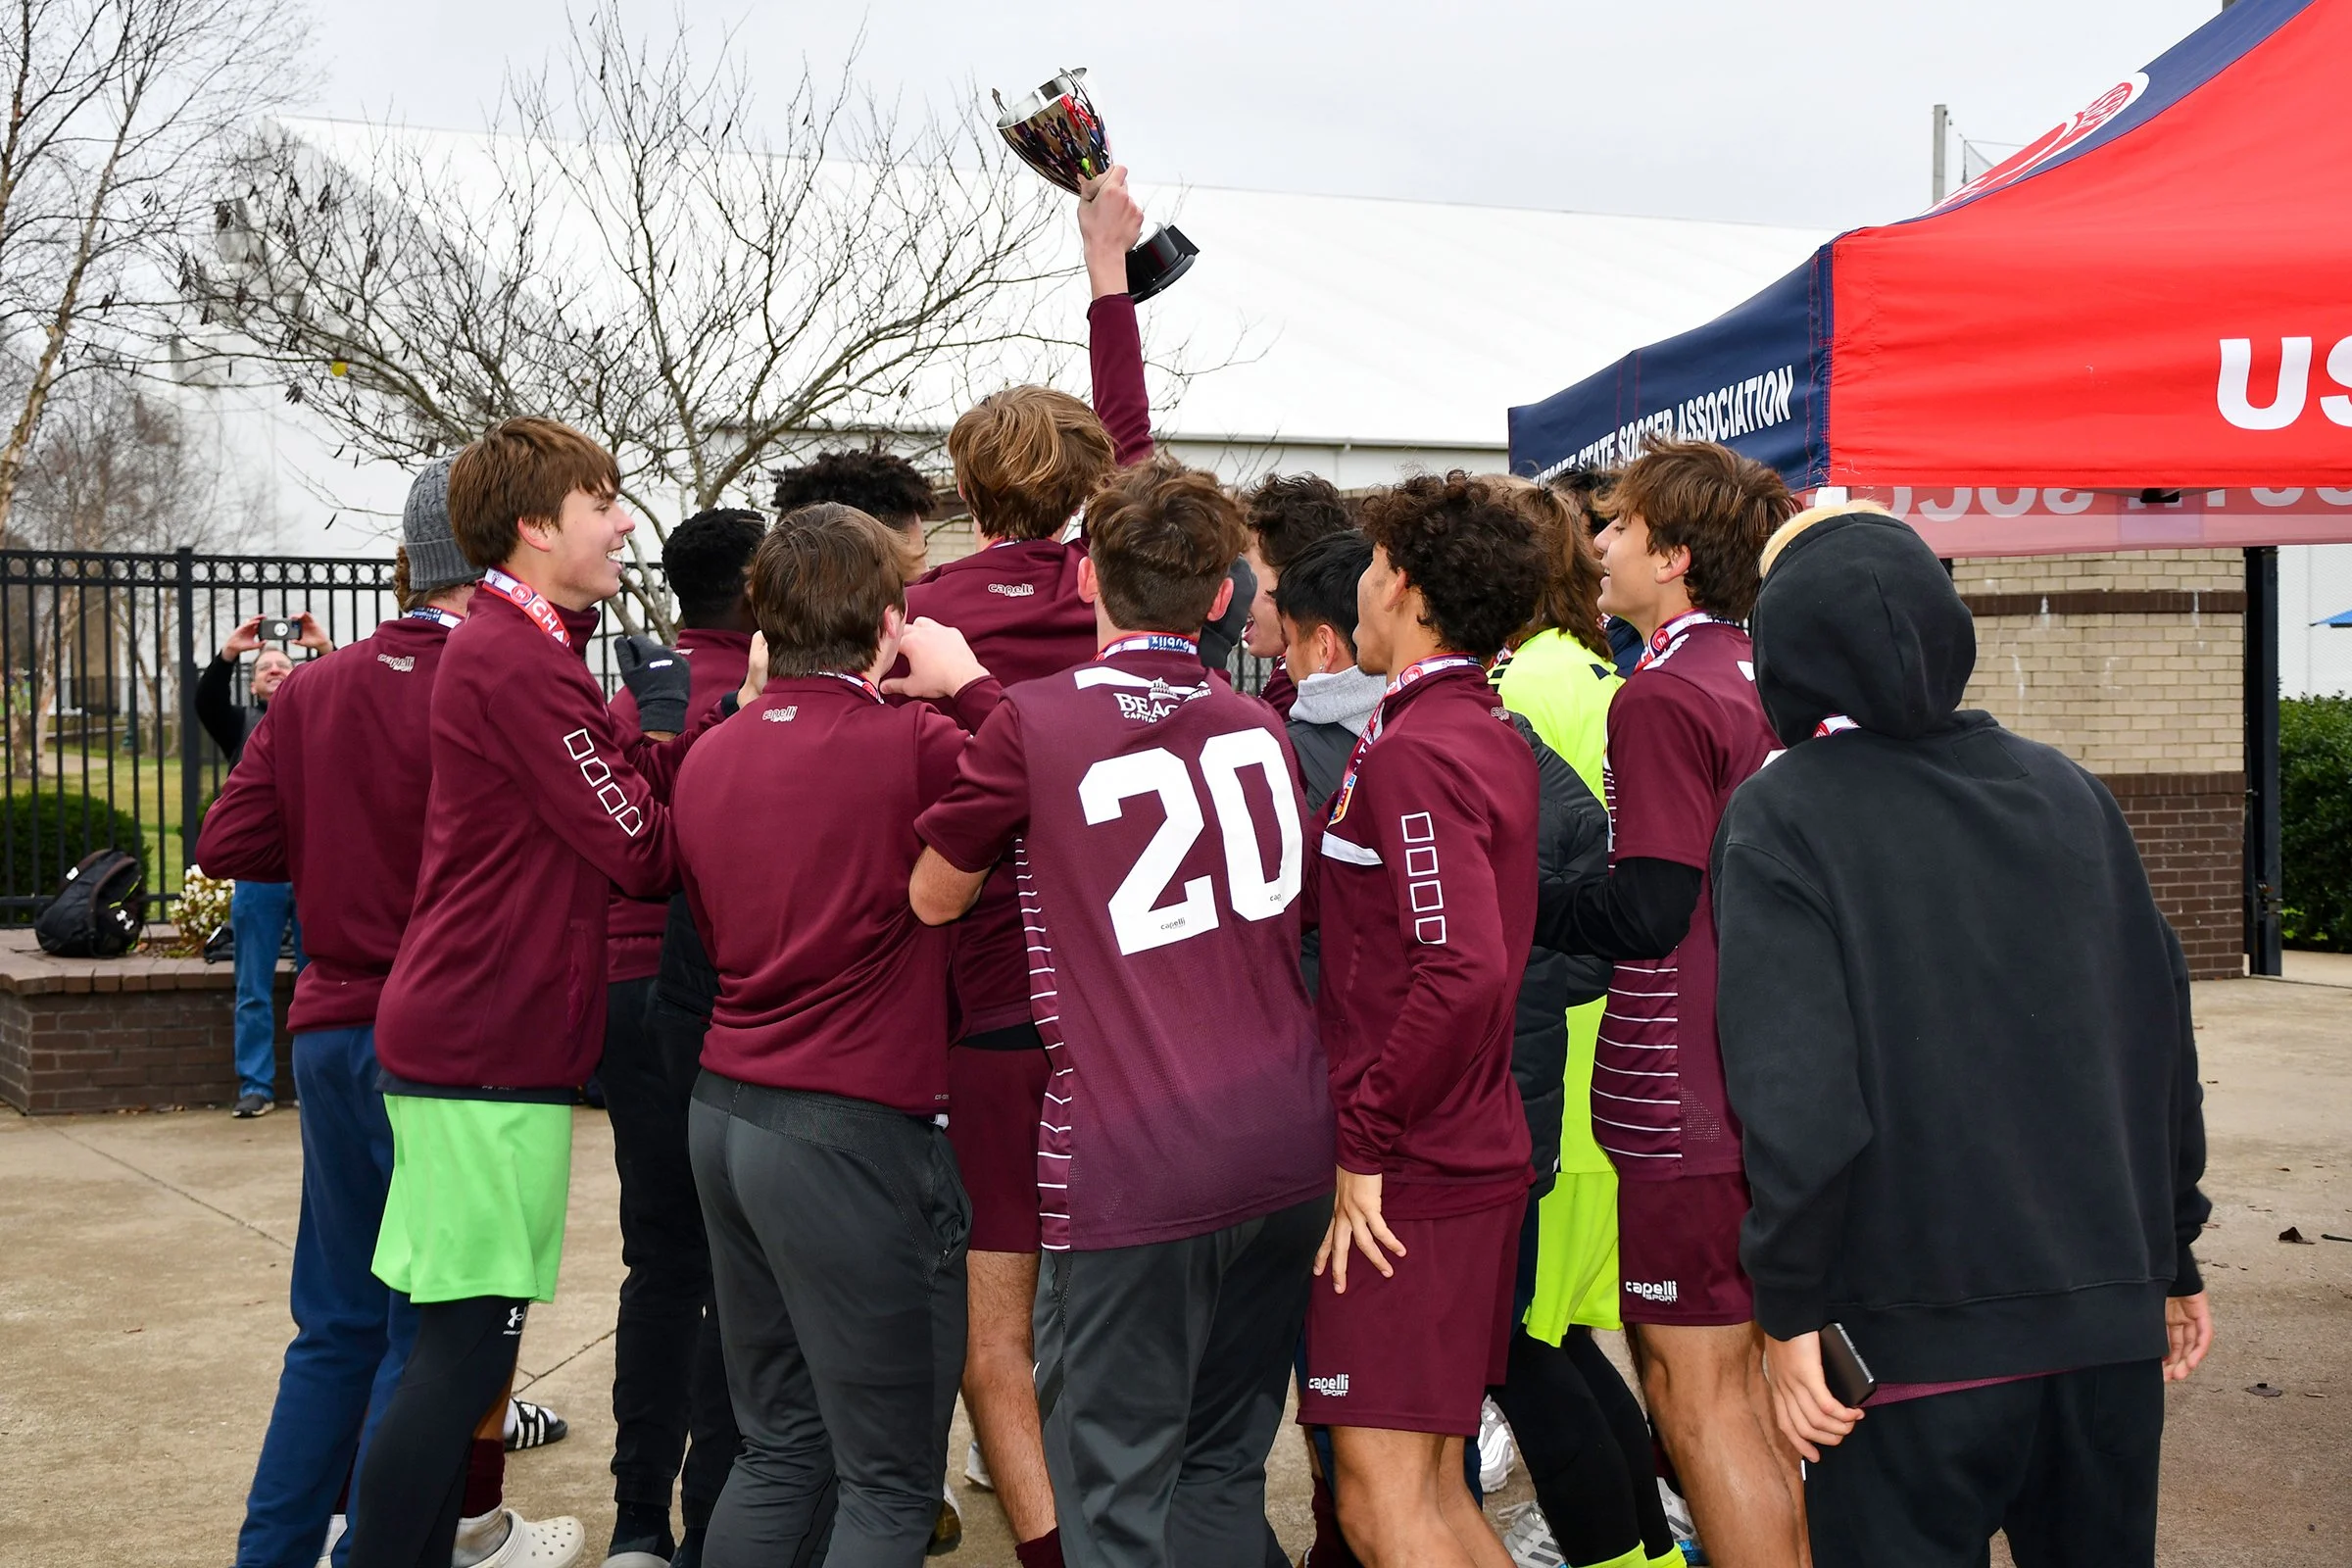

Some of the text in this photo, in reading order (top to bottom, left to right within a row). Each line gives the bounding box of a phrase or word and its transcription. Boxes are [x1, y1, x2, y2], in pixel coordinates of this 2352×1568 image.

[1579, 432, 1616, 471] STATE
[1618, 409, 1674, 468] SOCCER
[1677, 365, 1794, 443] ASSOCIATION
[988, 583, 1034, 596] capelli
[532, 601, 570, 648] CHA
[1078, 727, 1303, 956] 20
[1160, 917, 1186, 930] capelli
[1625, 1280, 1678, 1298] capelli
[1645, 1294, 1678, 1302] SPORT
[1308, 1374, 1349, 1393] capelli
